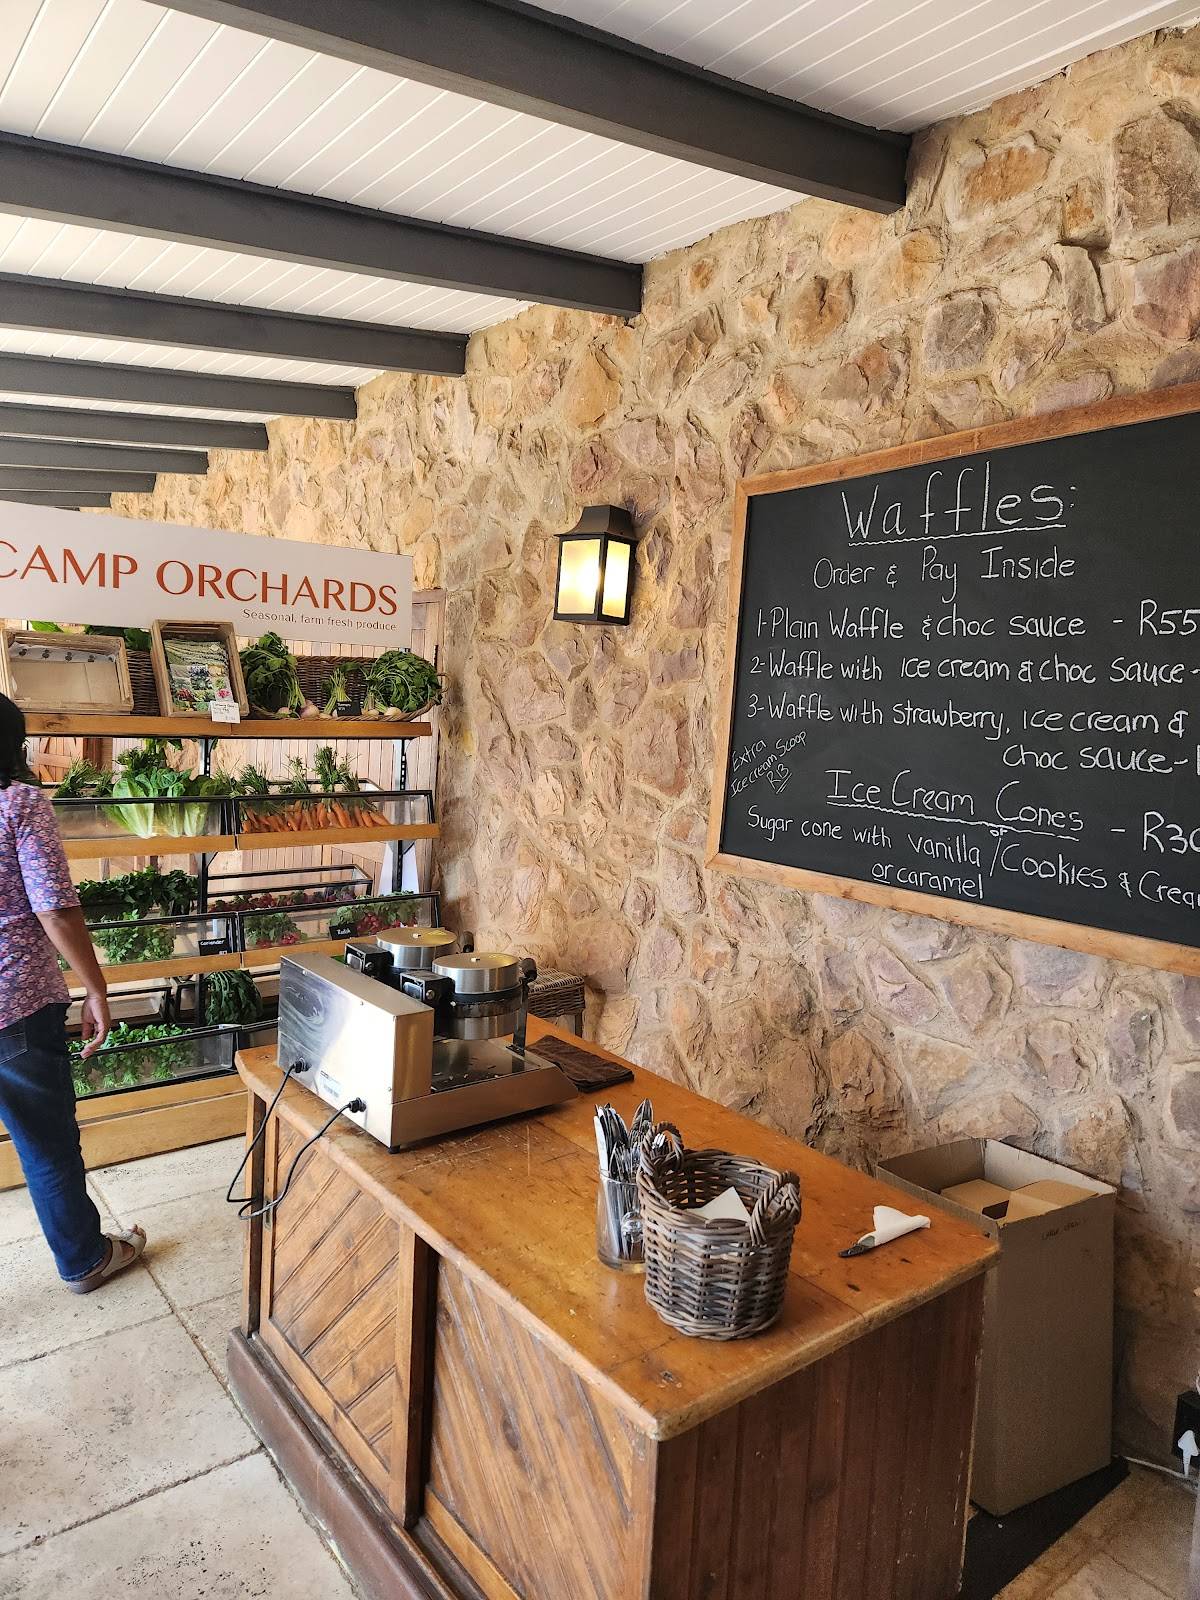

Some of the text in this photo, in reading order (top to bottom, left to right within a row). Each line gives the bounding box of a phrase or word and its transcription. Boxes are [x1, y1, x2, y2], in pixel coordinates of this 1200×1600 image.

[841, 461, 1077, 538] Waffles:
[156, 560, 398, 616] ORCHARDS
[813, 545, 1076, 603] Order & Pay Inside
[243, 608, 397, 631] Seasonal, farm fresh produce
[829, 607, 904, 639] Waffle
[1008, 615, 1086, 637] sauce
[840, 655, 883, 681] with
[937, 658, 1010, 681] cream
[840, 699, 884, 725] with
[1069, 711, 1159, 734] cream
[732, 740, 767, 772] Extra
[825, 769, 881, 804] Ice
[891, 769, 975, 815] Cream
[995, 781, 1084, 831] Cones
[748, 804, 793, 841] Sugar
[801, 819, 842, 840] cone
[852, 825, 891, 848] with
[1139, 870, 1200, 910] Crea
[871, 862, 984, 899] or caramel
